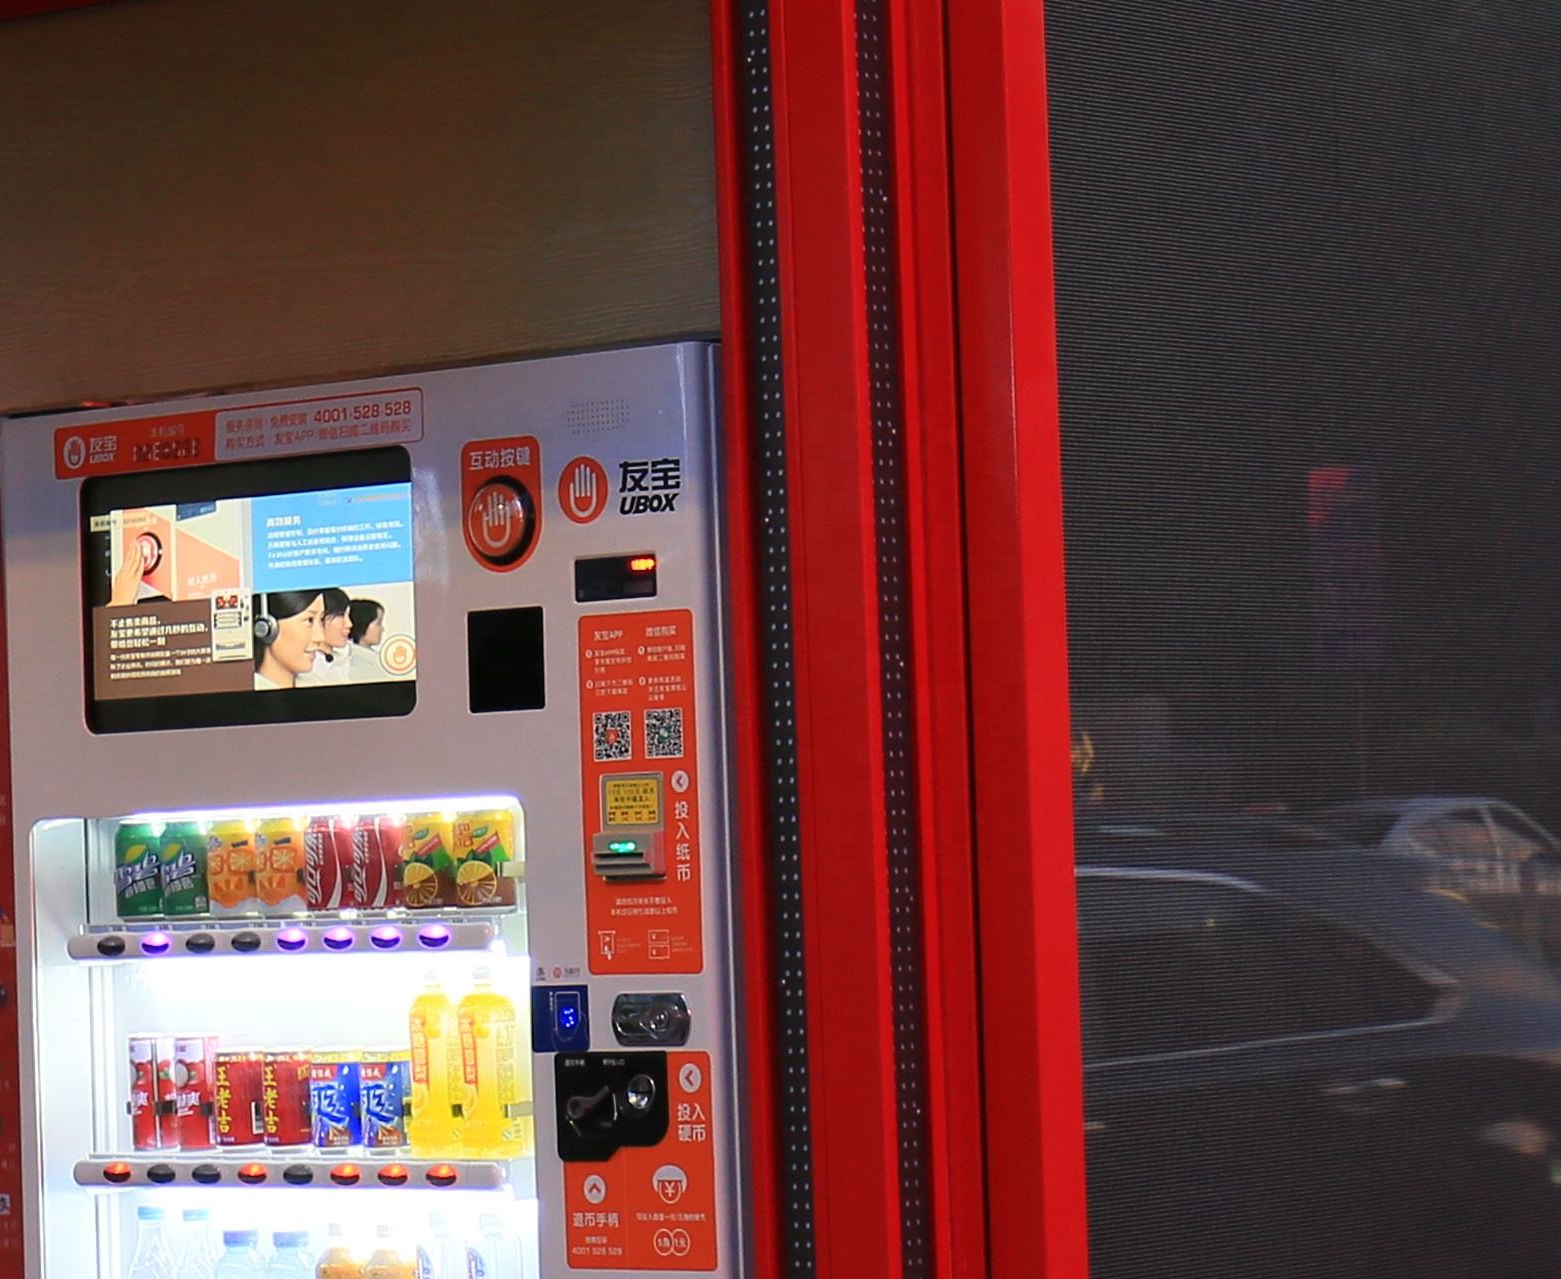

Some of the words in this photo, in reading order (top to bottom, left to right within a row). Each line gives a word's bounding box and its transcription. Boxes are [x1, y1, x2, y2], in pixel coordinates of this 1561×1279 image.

[89, 435, 117, 453] 友宝
[470, 447, 531, 470] 互动按键
[619, 458, 681, 493] 友宝
[619, 493, 679, 516] UBOX
[674, 800, 691, 882] 投入纸币
[216, 1065, 232, 1134] 王老吉
[263, 1065, 279, 1134] 王老吉
[677, 1102, 706, 1122] 投入
[677, 1124, 706, 1143] 硬币
[573, 1212, 619, 1228] 退币手柄
